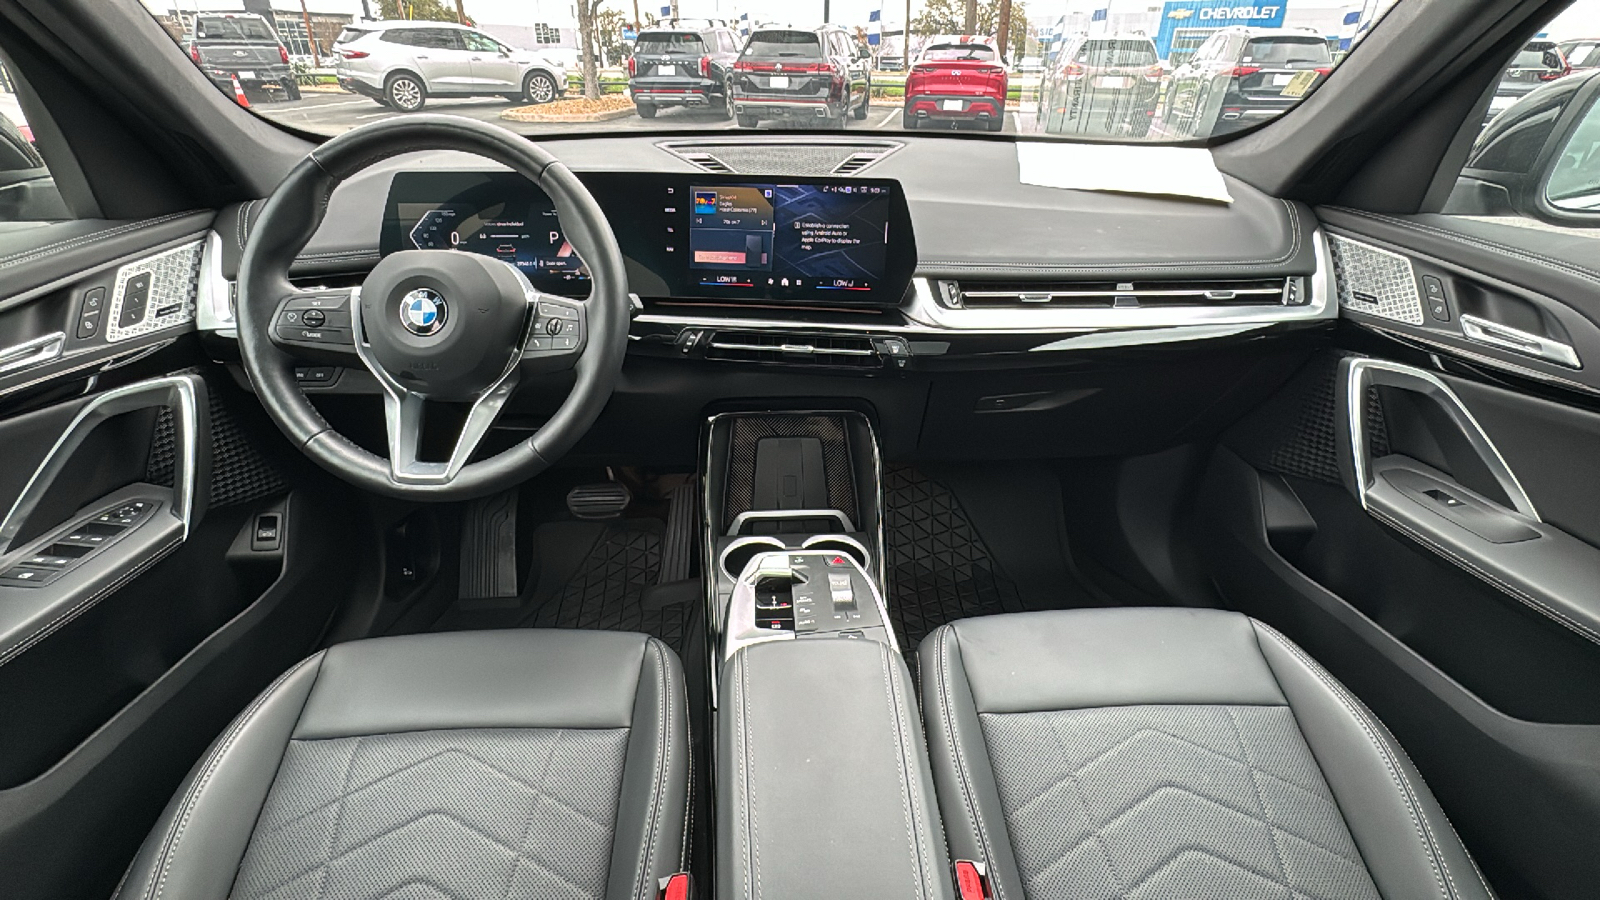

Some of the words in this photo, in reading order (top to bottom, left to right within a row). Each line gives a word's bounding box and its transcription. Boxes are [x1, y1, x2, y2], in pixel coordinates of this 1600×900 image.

[1200, 6, 1280, 20] CHEVROLET
[451, 232, 459, 245] 0
[550, 231, 559, 244] P
